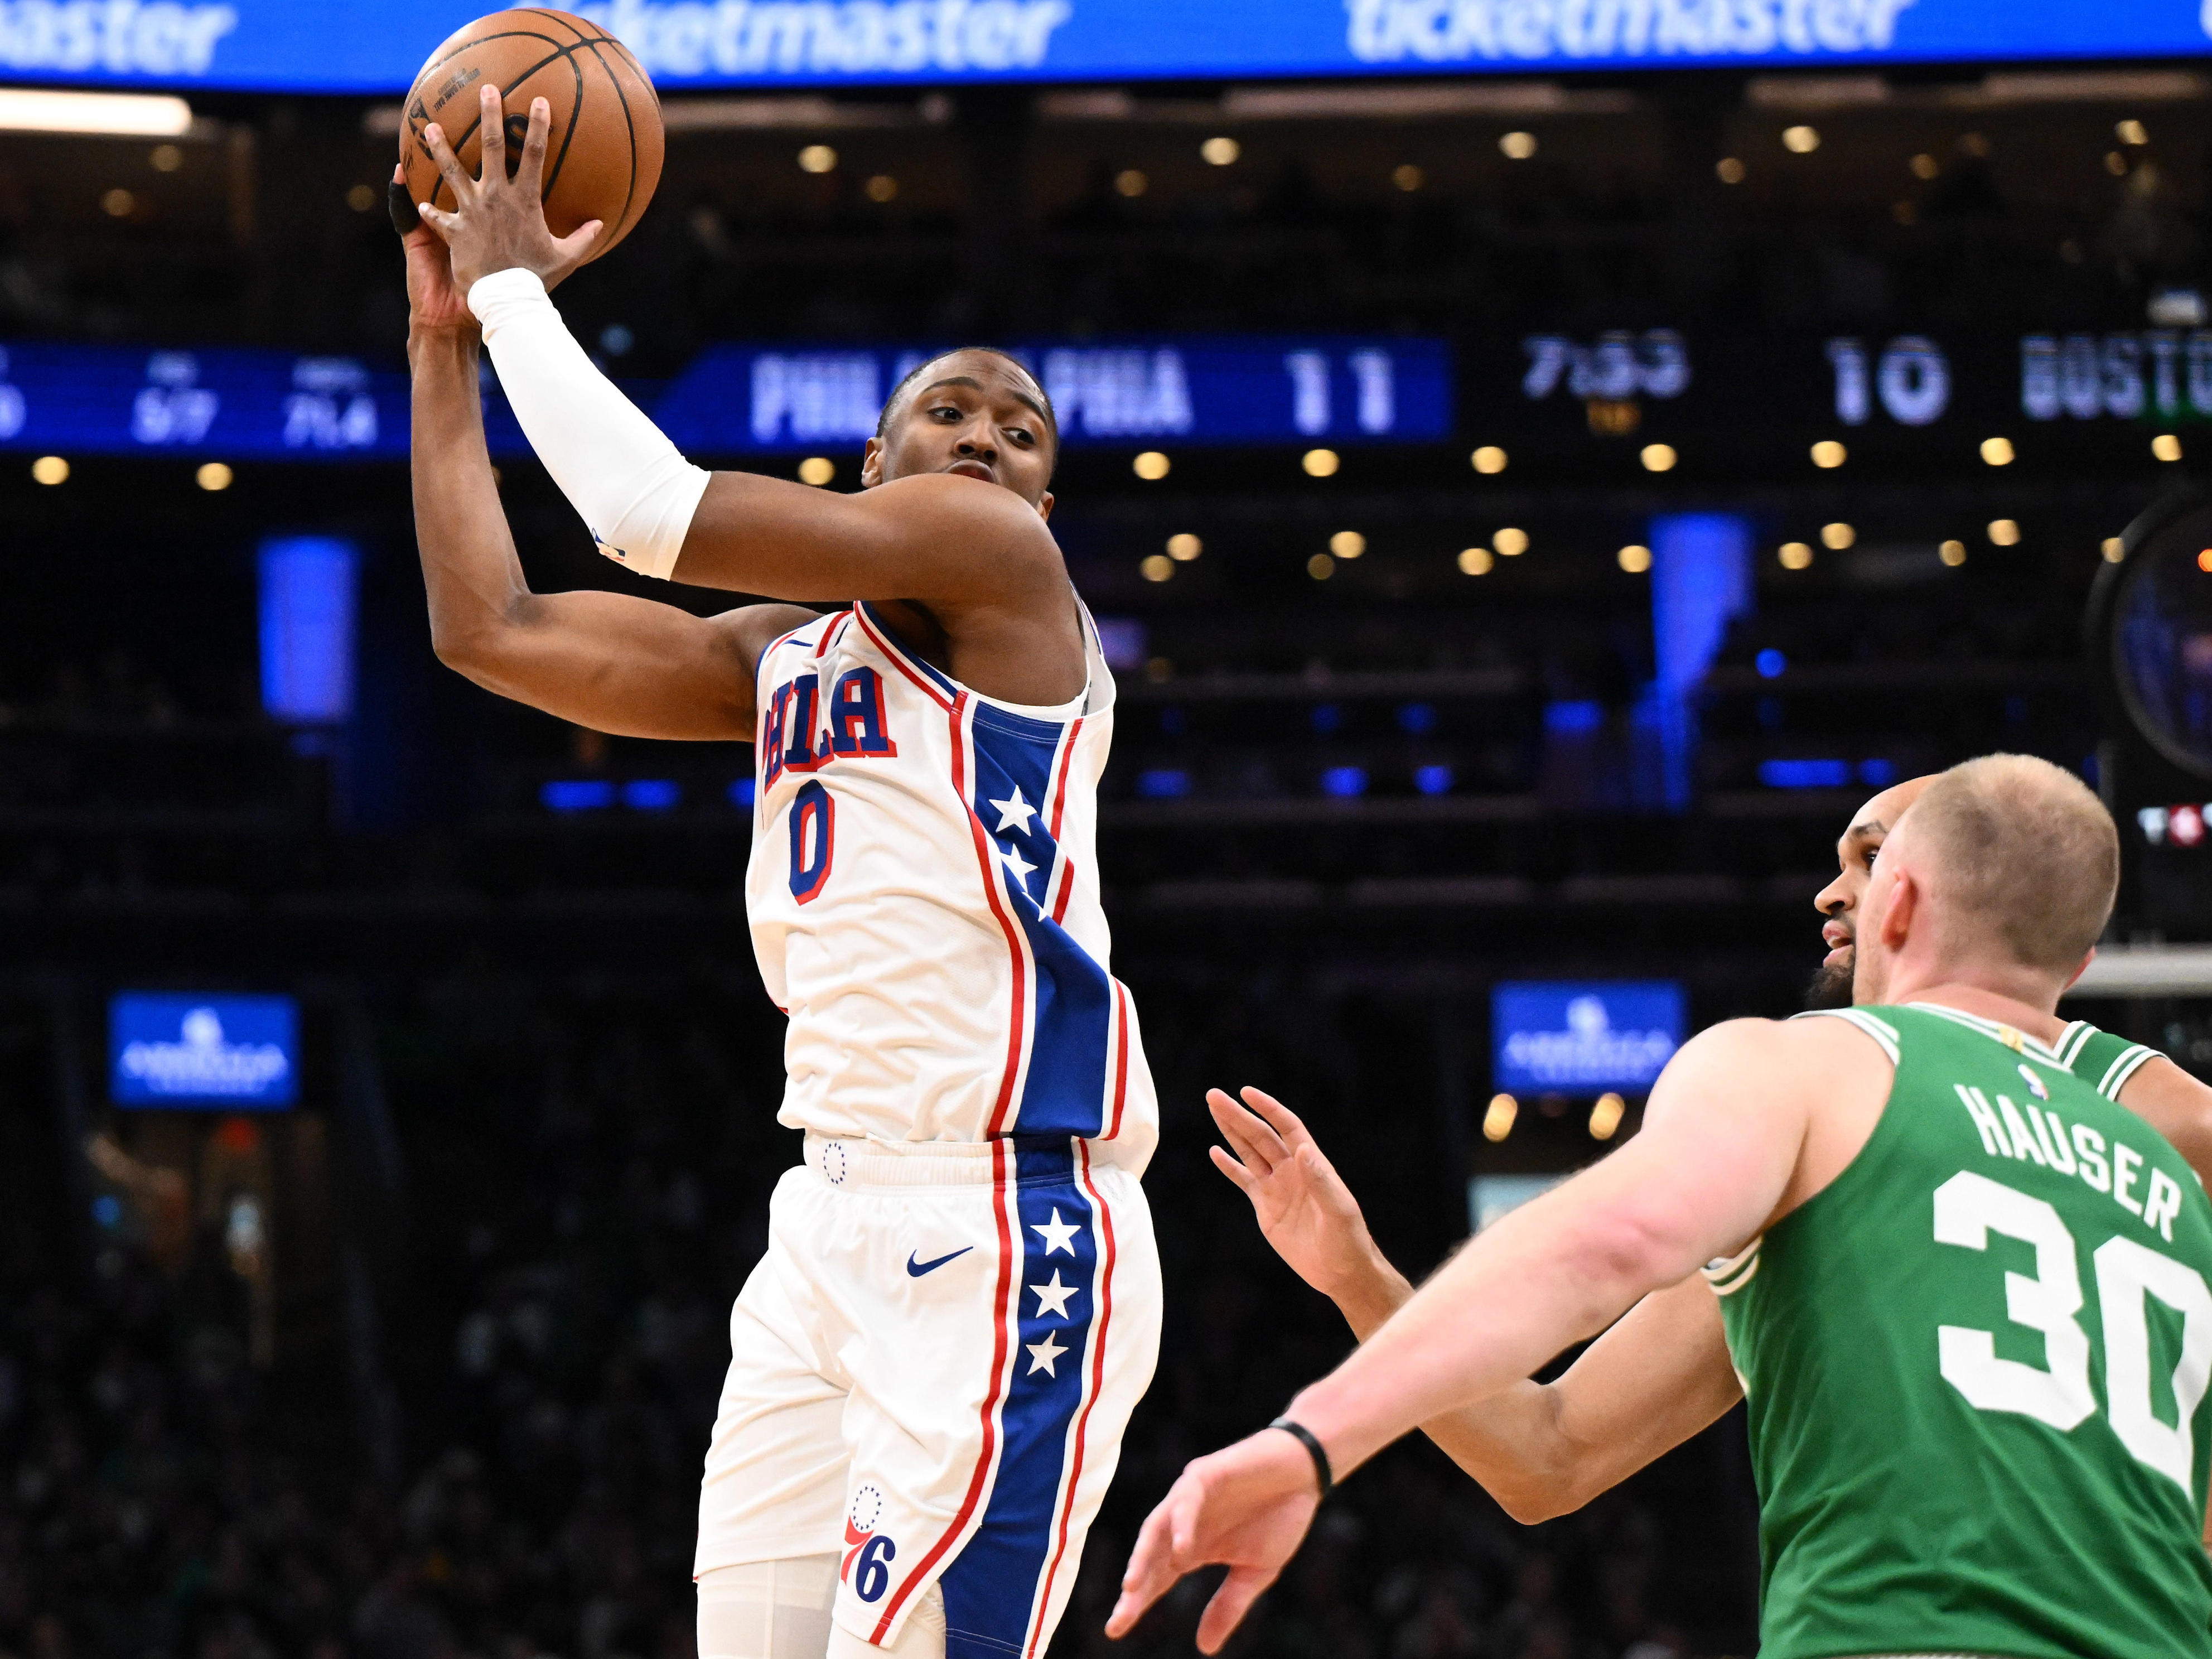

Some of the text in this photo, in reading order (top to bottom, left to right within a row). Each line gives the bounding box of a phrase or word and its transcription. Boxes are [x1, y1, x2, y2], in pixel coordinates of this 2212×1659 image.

[1284, 349, 1394, 435] 11
[1825, 336, 1951, 425] 10
[789, 778, 834, 906] 0
[1953, 1084, 2182, 1243] HAUSER
[1933, 1170, 2212, 1502] 30
[841, 1515, 896, 1603] 76
